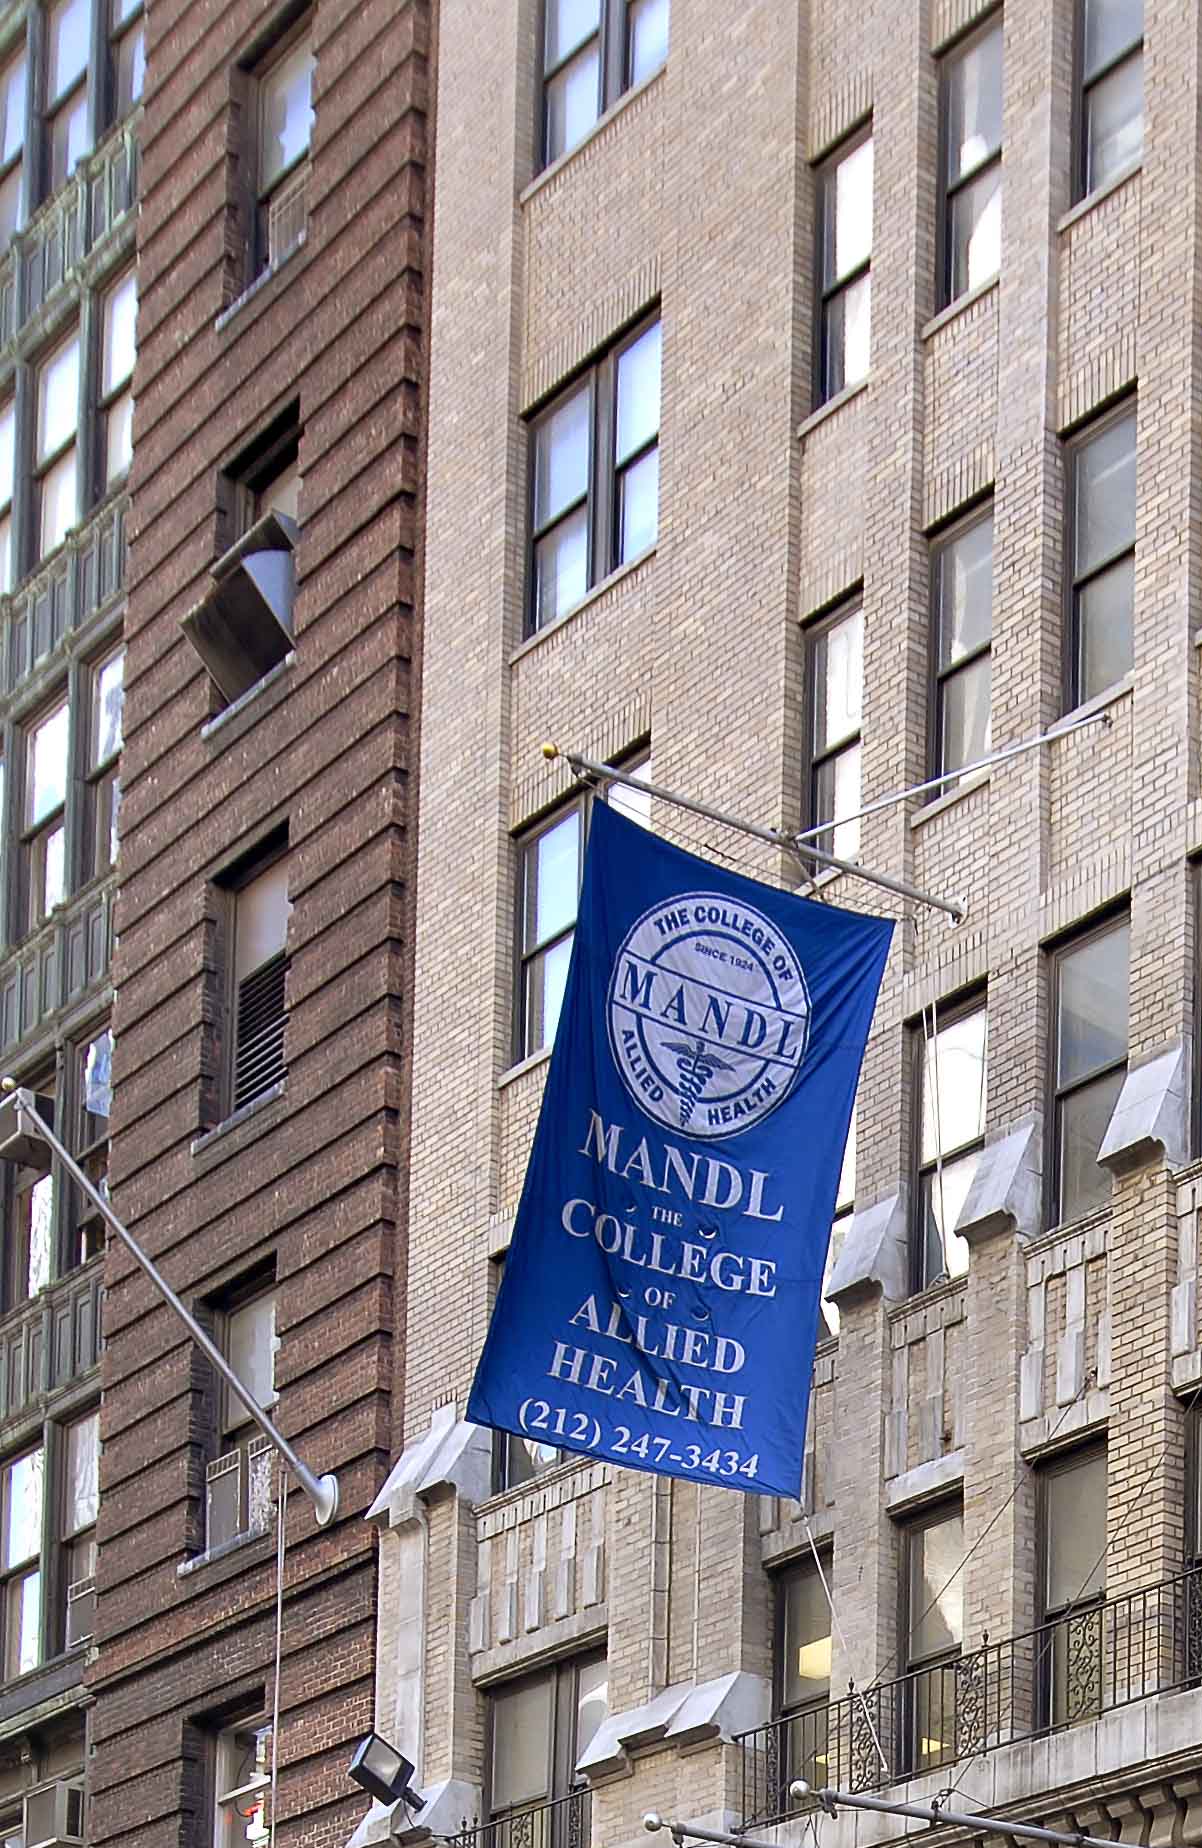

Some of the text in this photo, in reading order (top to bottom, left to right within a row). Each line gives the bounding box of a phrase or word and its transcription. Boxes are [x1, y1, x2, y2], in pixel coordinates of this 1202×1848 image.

[654, 906, 793, 982] THE COLLEGE OF
[695, 942, 754, 971] SINCE 1924
[619, 960, 798, 1061] MANDL
[622, 1029, 663, 1102] ALLIED
[707, 1078, 777, 1126] HEALTH
[578, 1108, 785, 1224] MANDL
[561, 1199, 777, 1297] COLLEGE
[651, 1205, 683, 1227] THE
[569, 1295, 746, 1376] ALLIED
[645, 1286, 676, 1310] OF
[547, 1340, 746, 1431] HEALTH
[518, 1397, 760, 1480] (212) 247-3434
